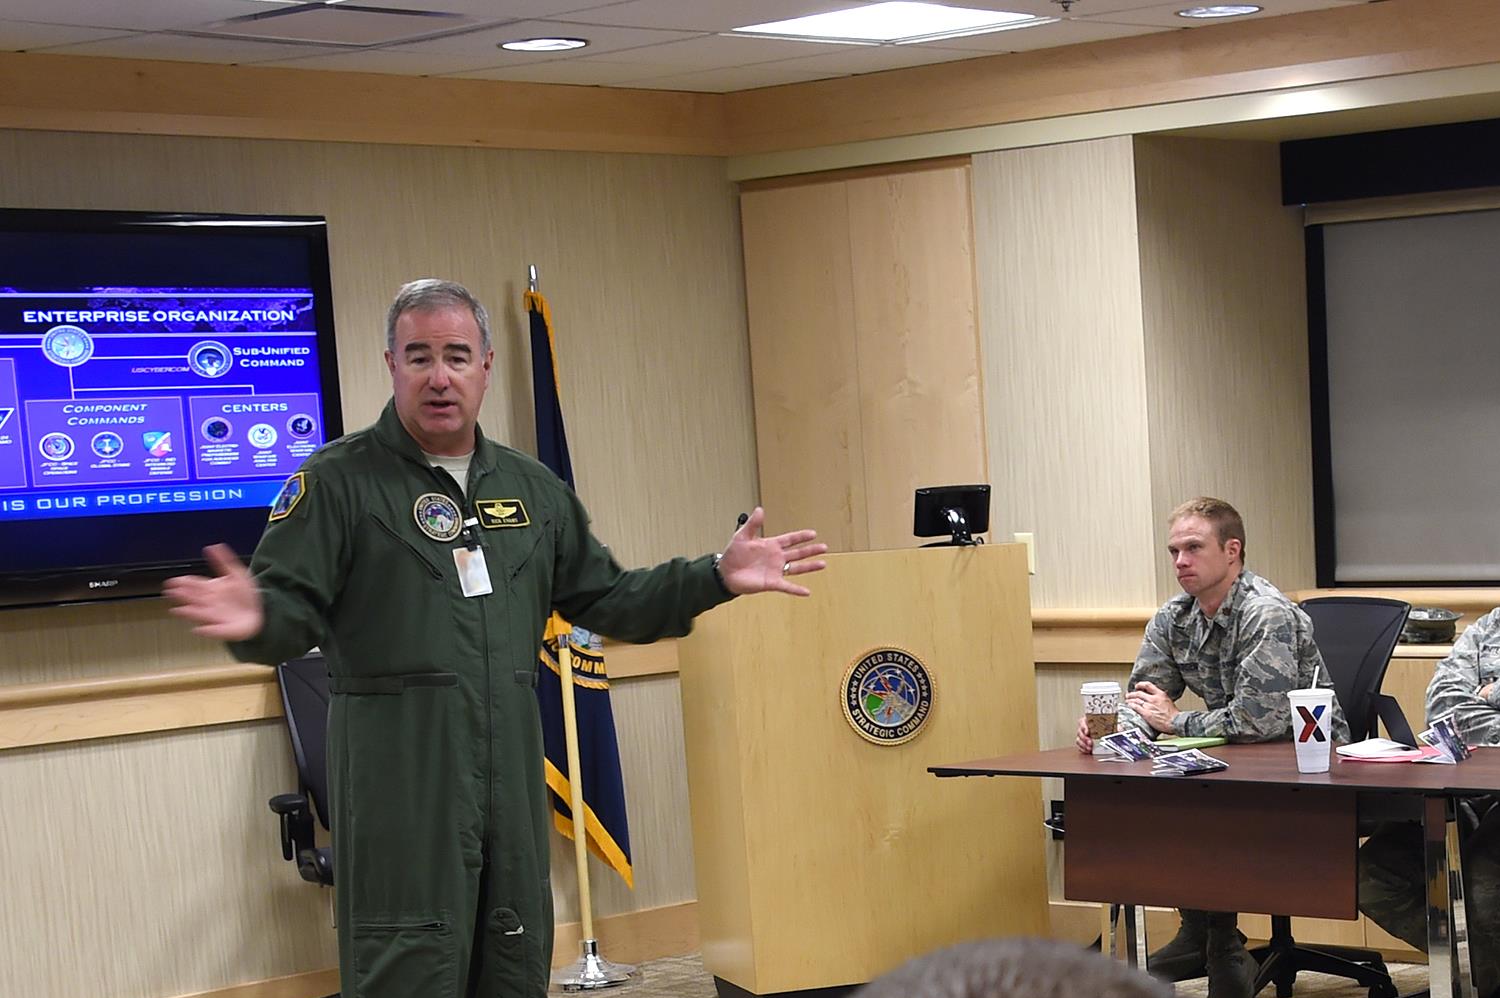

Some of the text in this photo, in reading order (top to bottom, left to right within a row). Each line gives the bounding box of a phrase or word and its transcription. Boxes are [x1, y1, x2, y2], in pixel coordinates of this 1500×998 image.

[23, 309, 295, 323] ENTERPRISE ORGANIZATION
[221, 403, 288, 413] CENTERS
[3, 488, 243, 511] IS OUR PROFESSION
[855, 652, 919, 679] UNITED STATES
[852, 700, 929, 738] STRATEGIC COMMAND
